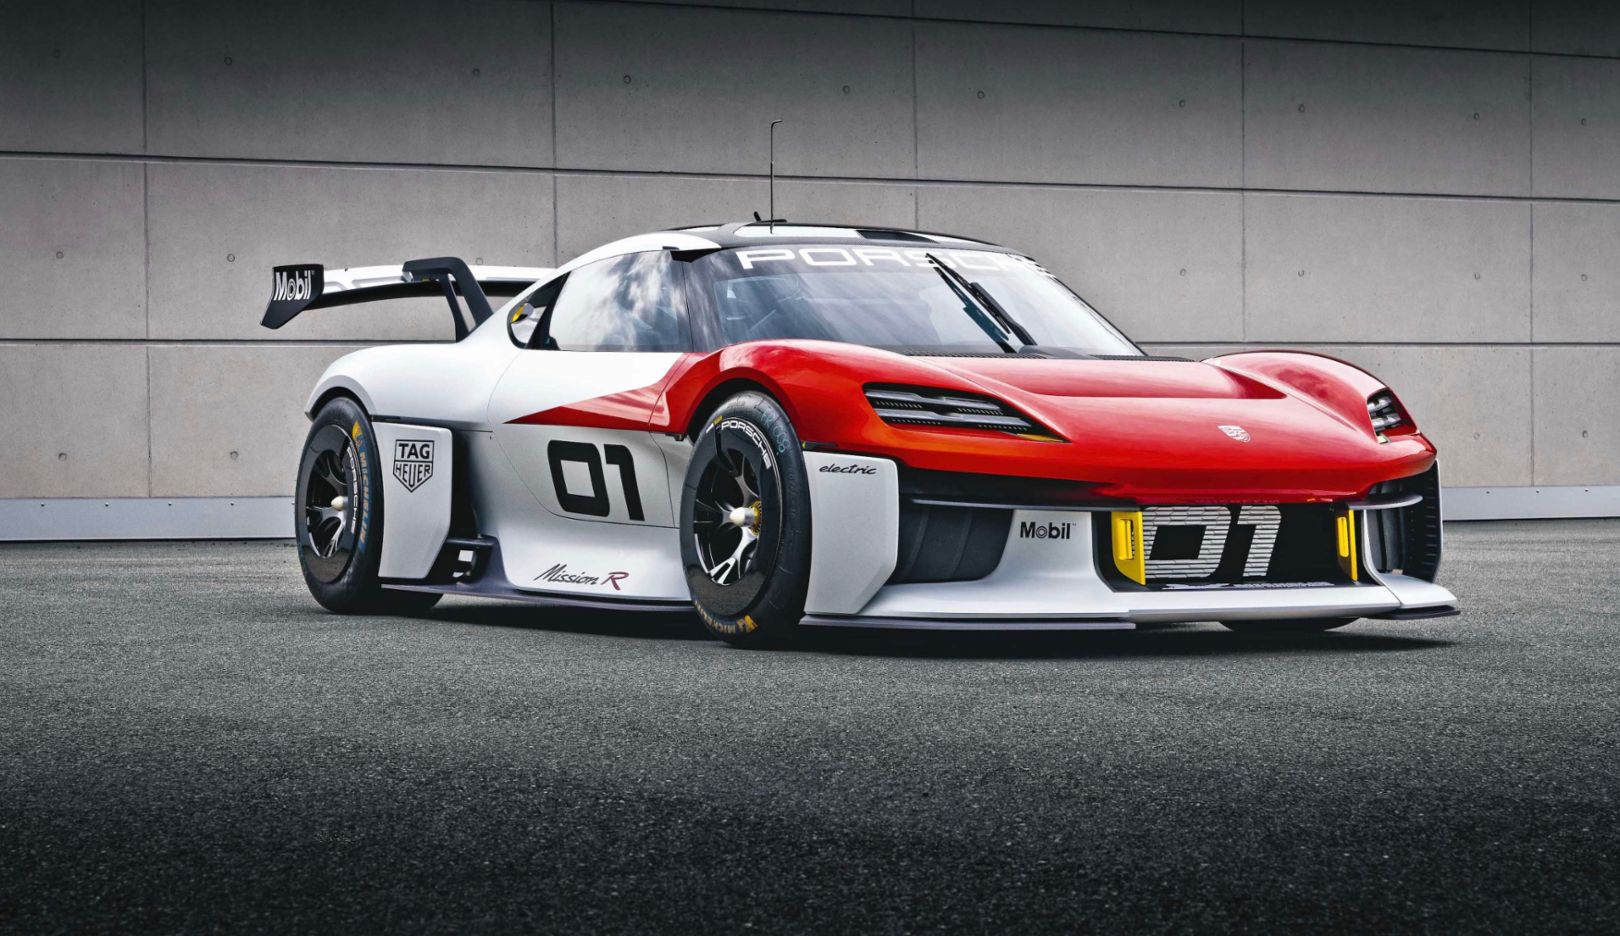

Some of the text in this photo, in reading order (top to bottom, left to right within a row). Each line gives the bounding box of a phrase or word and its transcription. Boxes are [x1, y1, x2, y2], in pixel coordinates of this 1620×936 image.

[273, 270, 312, 301] Mobil
[398, 443, 431, 460] TAG
[721, 420, 772, 470] PORSCHE
[395, 463, 432, 488] HEUER
[547, 439, 646, 522] 01
[819, 463, 877, 475] electric
[1020, 521, 1071, 540] Mobil
[1142, 505, 1282, 579] 01
[533, 563, 630, 591] Mission R
